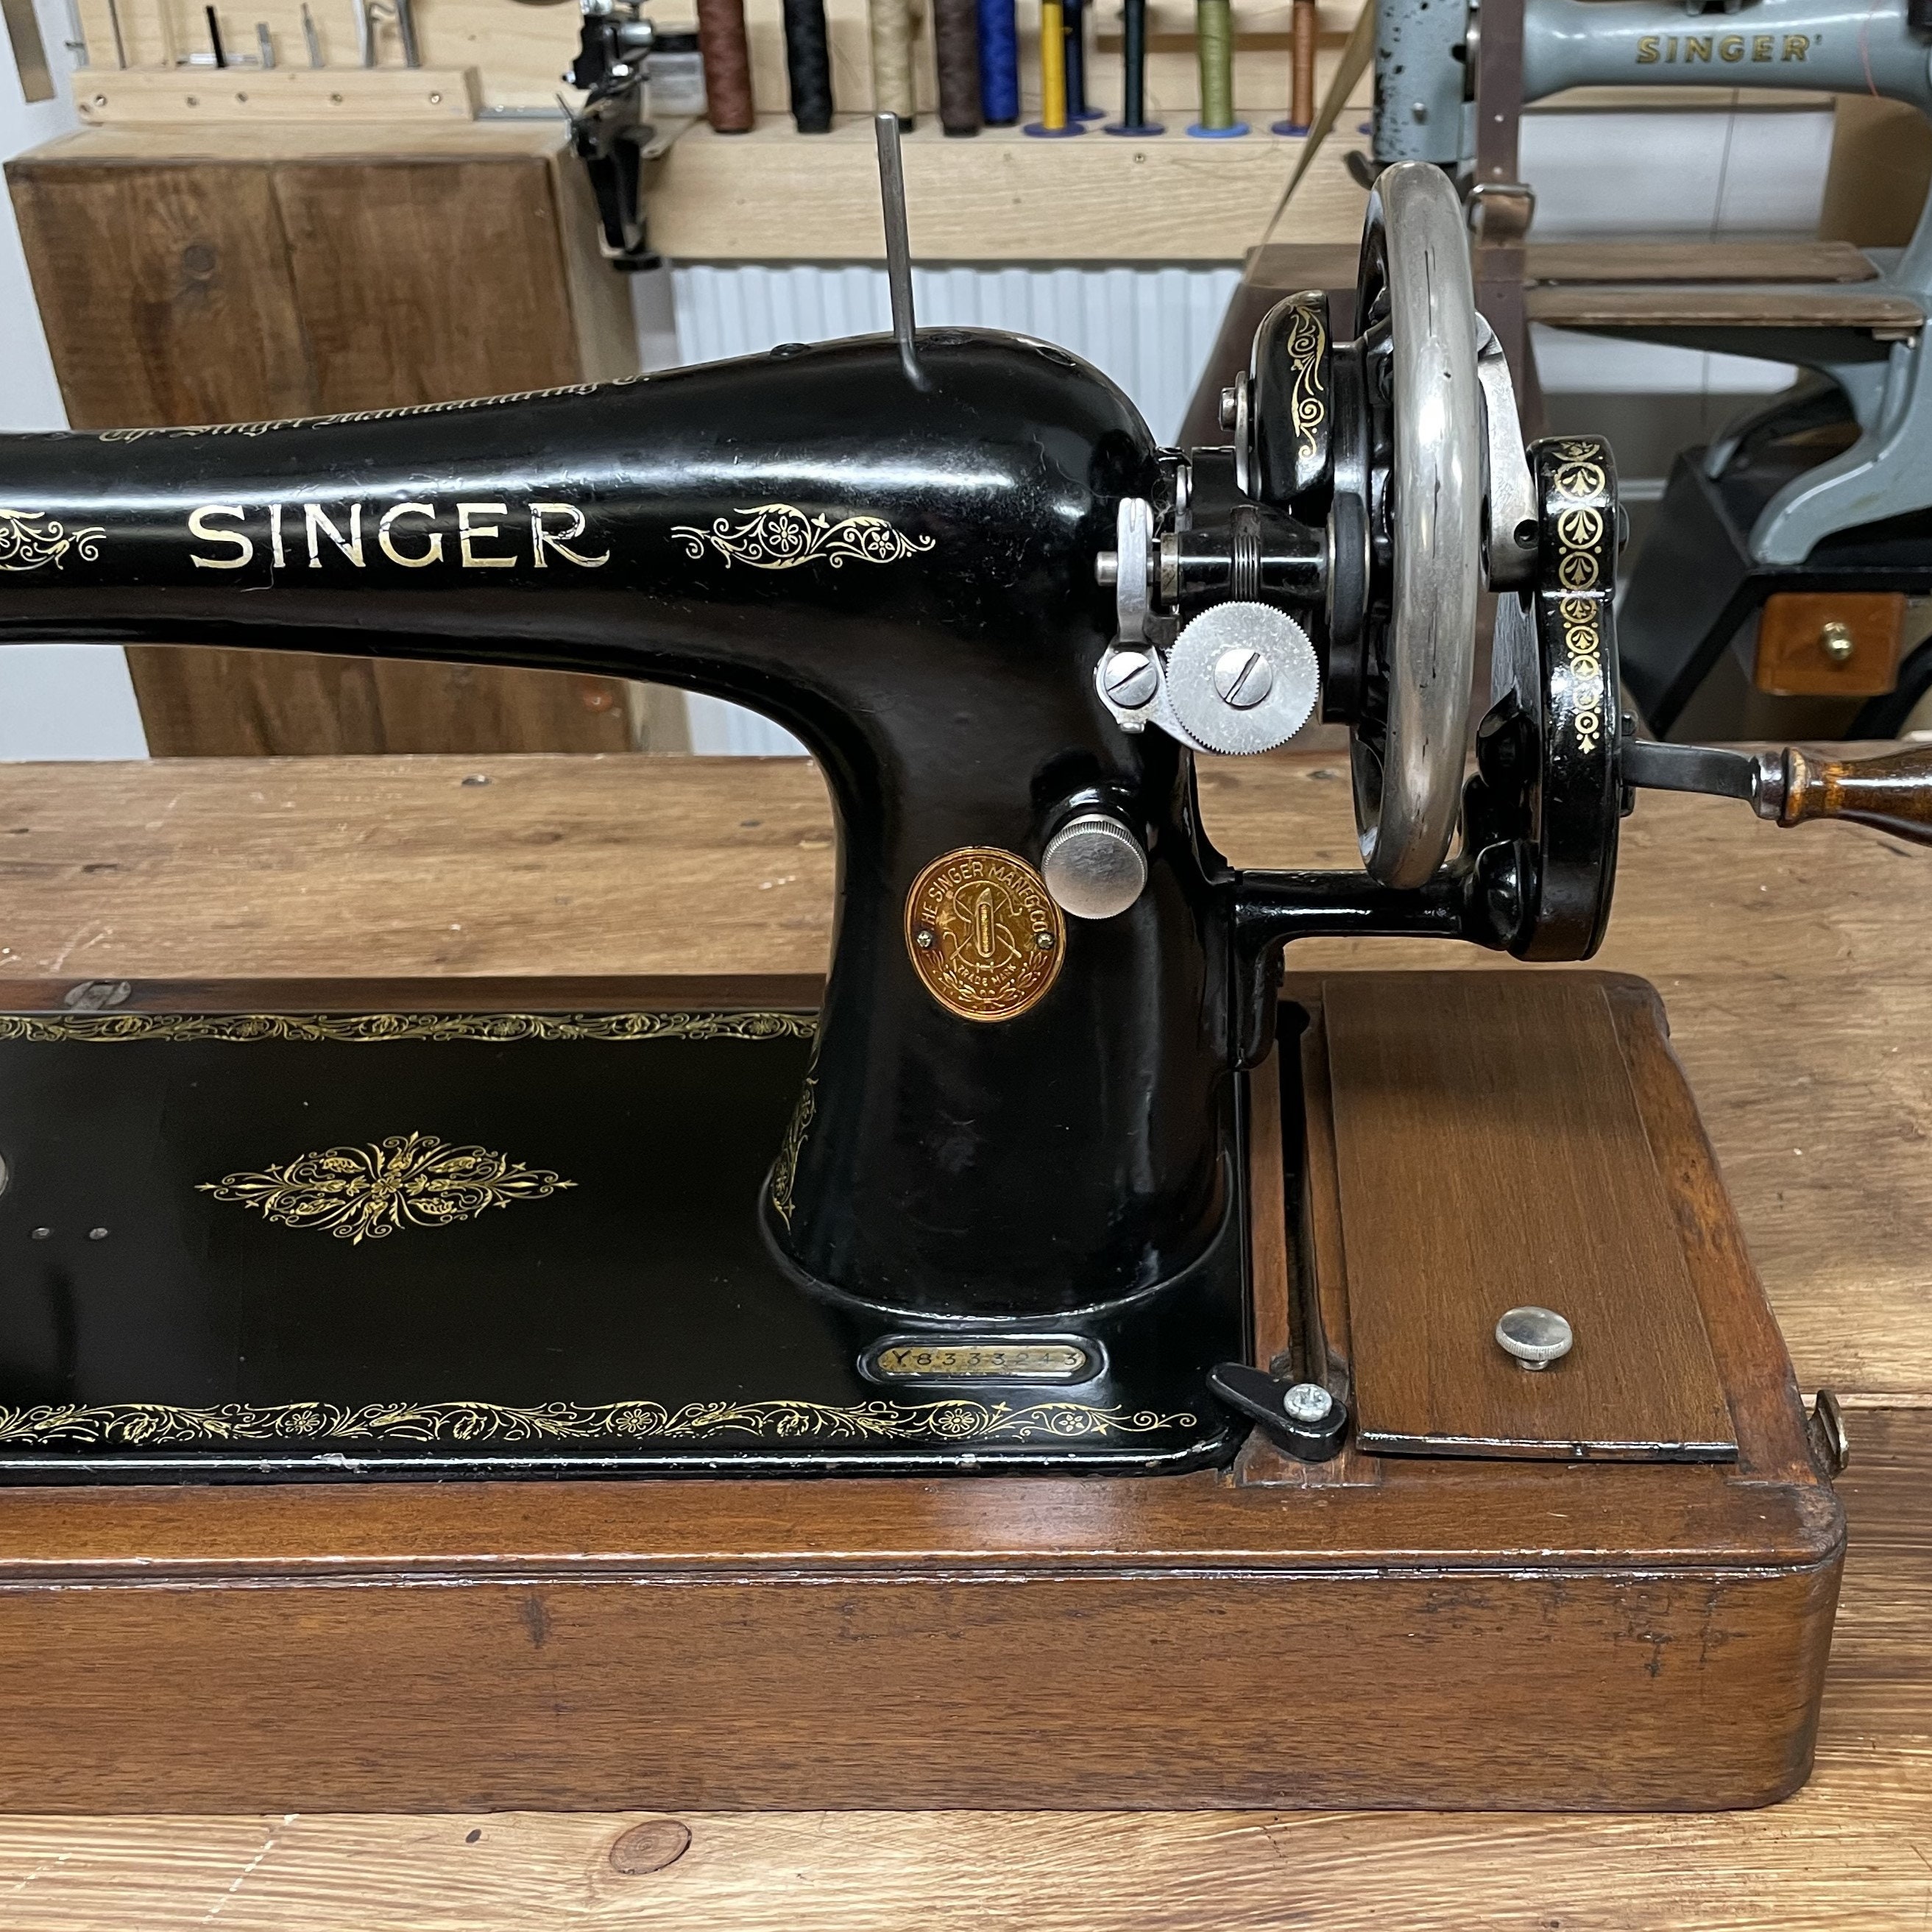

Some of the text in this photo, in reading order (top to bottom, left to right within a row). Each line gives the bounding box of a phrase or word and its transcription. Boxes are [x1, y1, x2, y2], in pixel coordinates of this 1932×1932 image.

[1635, 34, 1810, 63] SINGER
[188, 502, 611, 568] SINGER
[928, 861, 984, 902] SINGER
